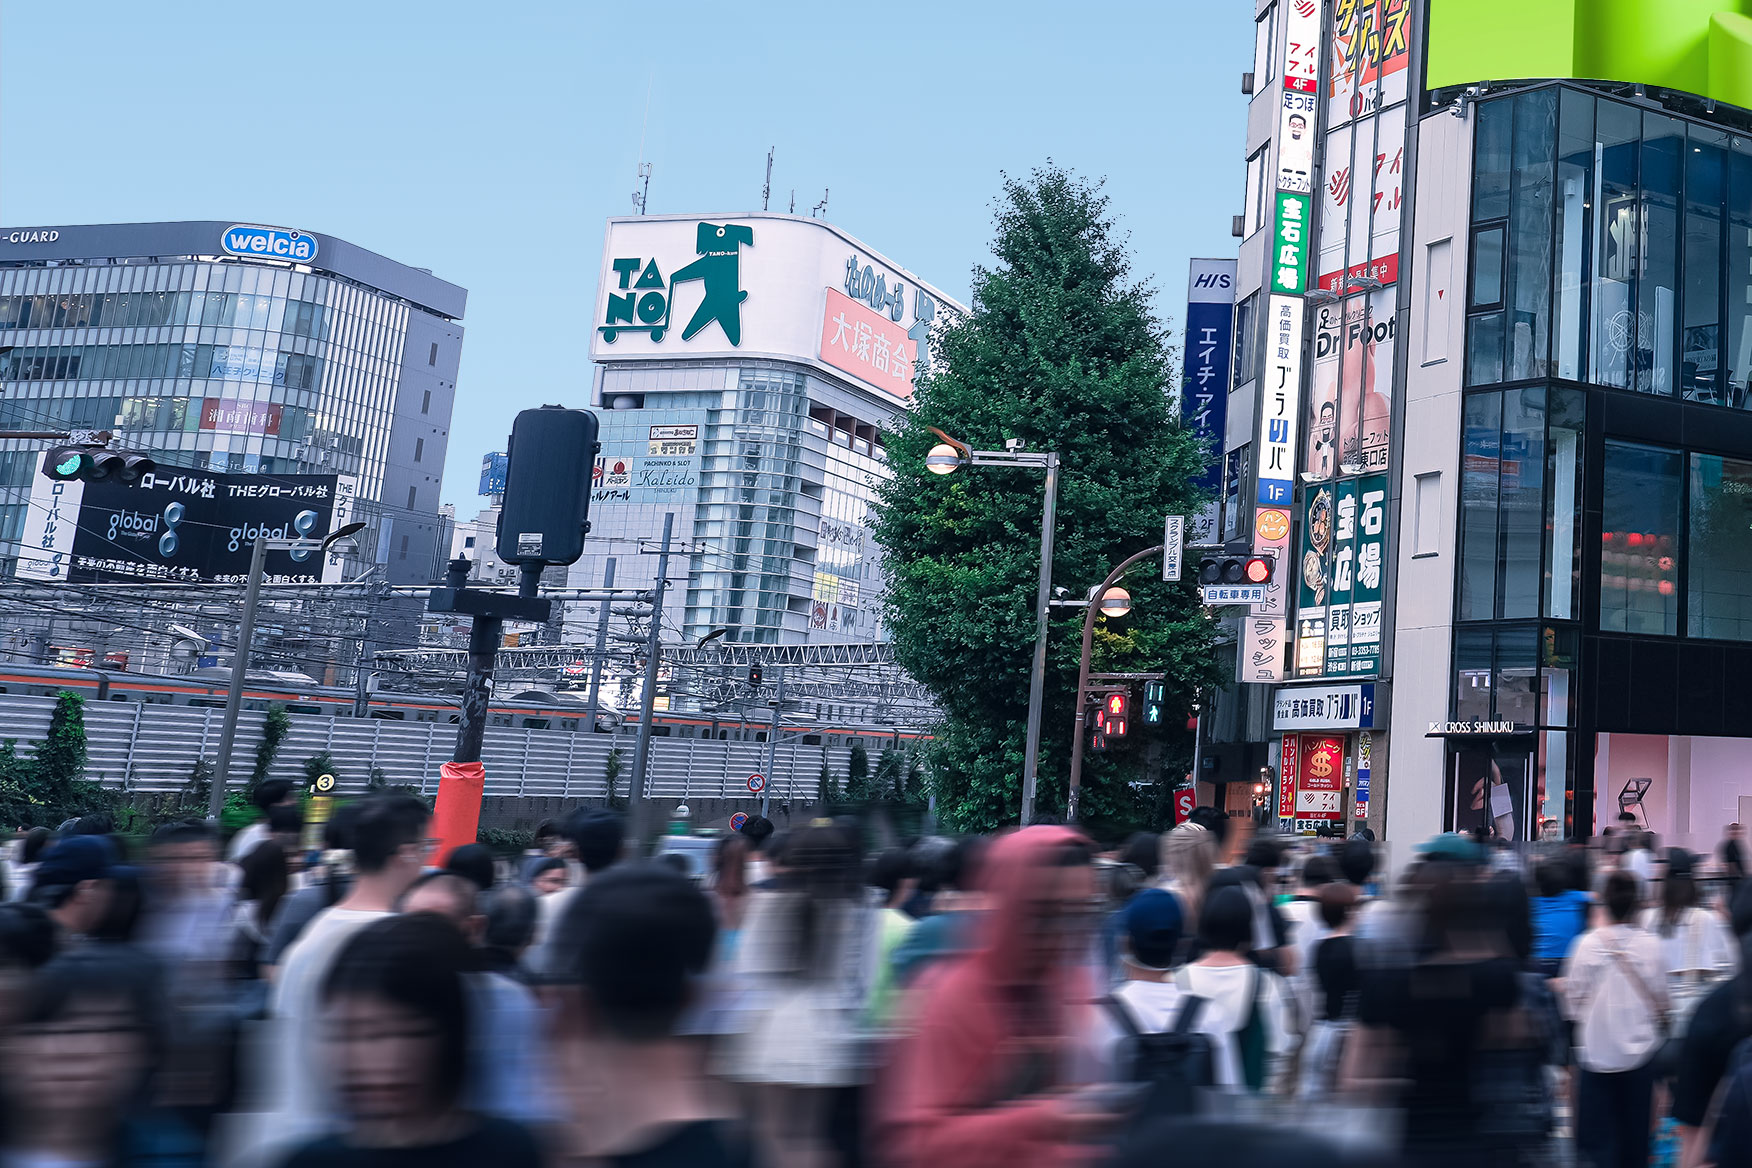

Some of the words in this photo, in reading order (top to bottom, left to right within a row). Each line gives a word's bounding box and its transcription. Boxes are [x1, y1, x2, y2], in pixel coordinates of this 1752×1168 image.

[1292, 79, 1308, 91] 4F
[0, 230, 59, 243] -GUARD
[230, 231, 310, 259] welcia
[1277, 197, 1303, 291] 宝石広場
[845, 254, 904, 322] たのめーる
[1277, 304, 1292, 361] 高価買取
[1349, 316, 1396, 350] Foot
[831, 312, 909, 382] 大塚商会
[1269, 365, 1292, 471] ブラリバ
[141, 472, 216, 499] ローバル社
[636, 469, 695, 486] Kaleido
[228, 484, 329, 499] THEグローバル社
[1268, 484, 1285, 500] 1F
[107, 509, 160, 541] global
[1201, 519, 1214, 530] 2F
[1337, 490, 1384, 540] 宝石
[228, 522, 289, 552] global
[214, 574, 319, 584] 未来の不を面白くする。
[1334, 542, 1381, 592] 広場
[1208, 589, 1261, 600] 自転車専用
[1292, 698, 1324, 719] 高価買取
[1363, 696, 1372, 715] 1F
[1445, 721, 1471, 733] CROSS
[1474, 721, 1514, 733] SHINJUKU
[320, 777, 330, 788] 3
[1355, 808, 1365, 816] 6F
